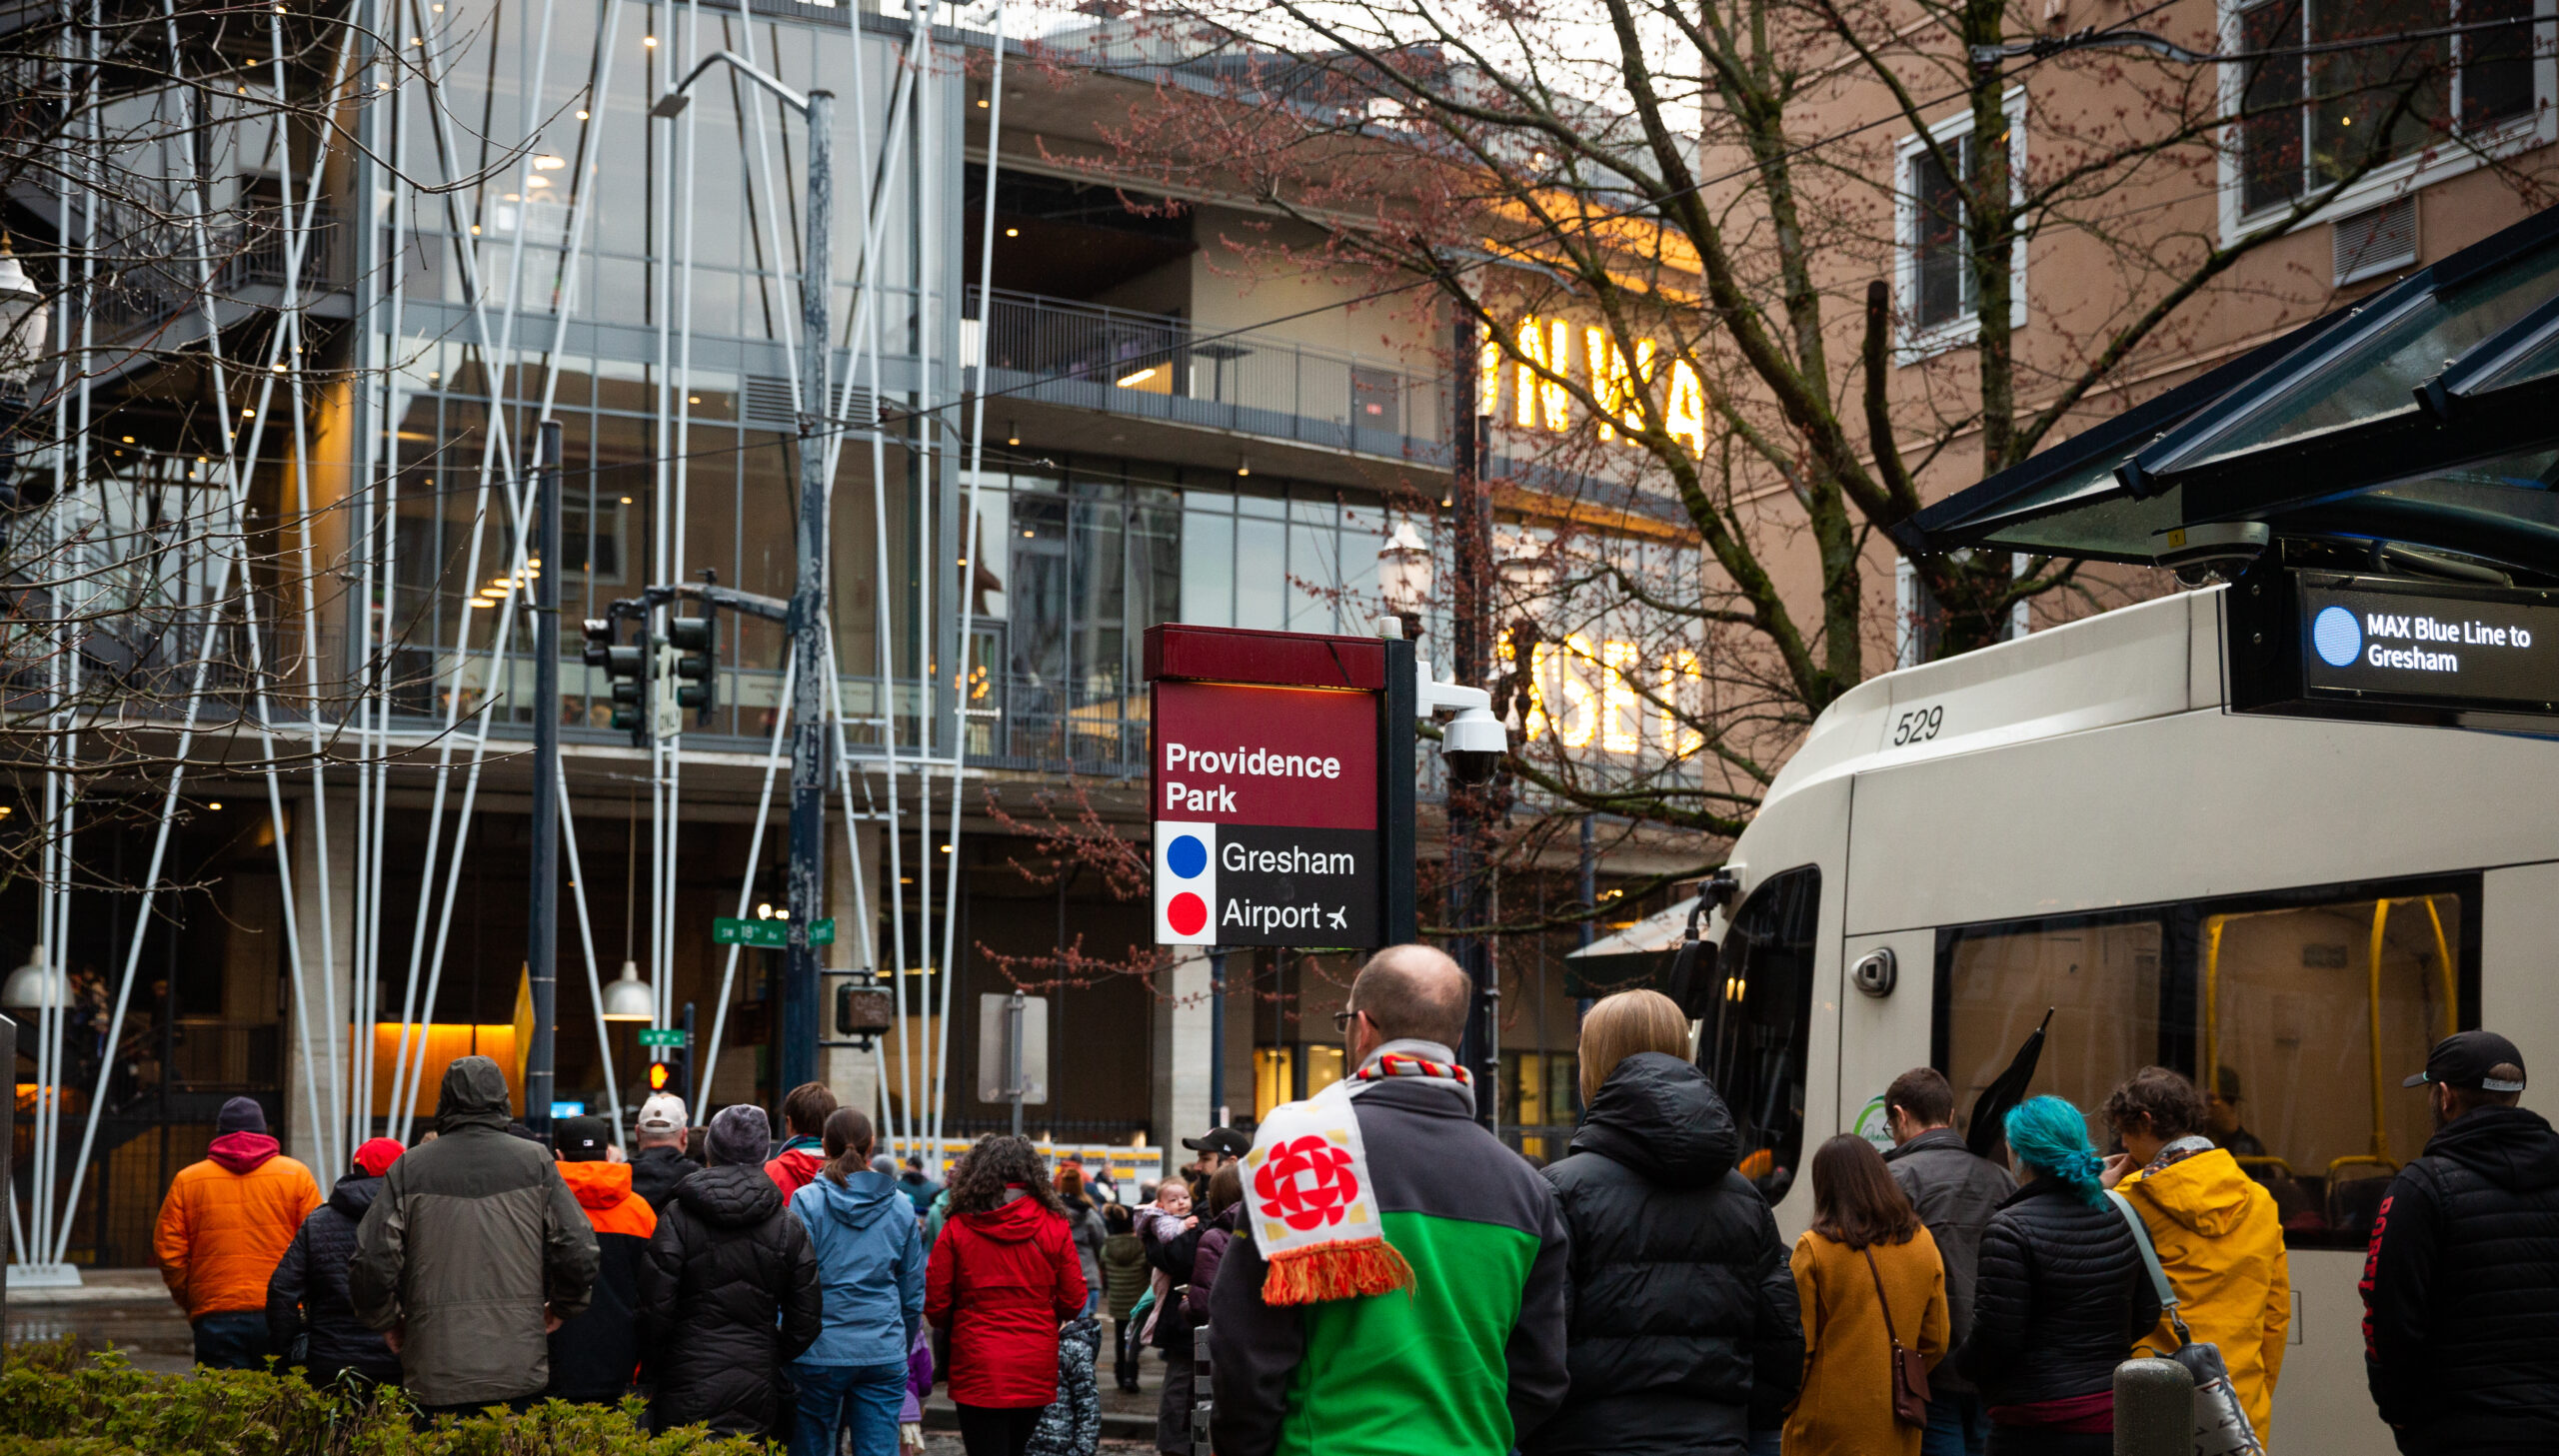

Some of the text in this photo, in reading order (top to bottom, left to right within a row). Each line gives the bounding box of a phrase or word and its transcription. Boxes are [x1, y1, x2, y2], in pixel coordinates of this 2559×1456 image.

[2367, 614, 2532, 648] MAX Blue Line to
[2367, 644, 2459, 673] Gresham
[1893, 705, 1944, 746] 529
[1166, 742, 1340, 779] Providence
[1166, 781, 1238, 812] Park
[1222, 841, 1355, 875] Gresham
[1221, 897, 1321, 935] Airport
